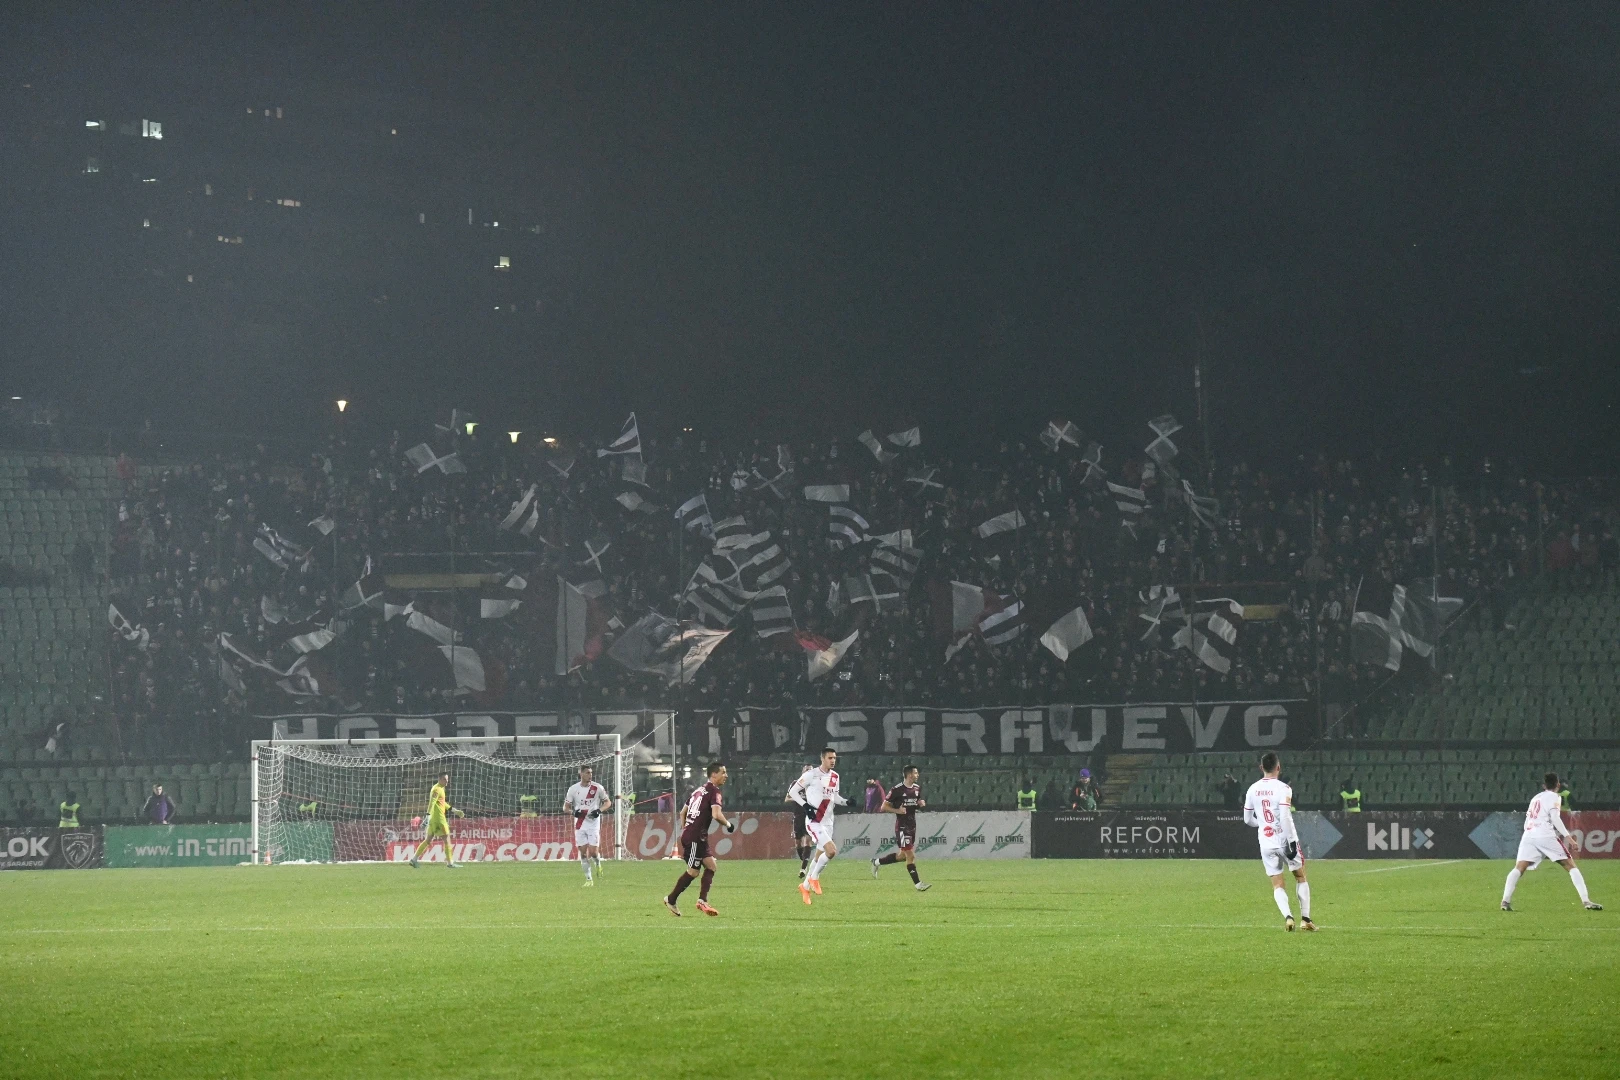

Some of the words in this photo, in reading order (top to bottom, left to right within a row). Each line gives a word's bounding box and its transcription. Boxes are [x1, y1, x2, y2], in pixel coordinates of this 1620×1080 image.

[826, 704, 1288, 754] SARAJEVO
[1262, 799, 1275, 824] 6
[460, 828, 513, 839] AIRLINES
[1100, 826, 1200, 844] REFORM
[1367, 822, 1435, 850] klix
[1103, 846, 1196, 854] www.reform.ba
